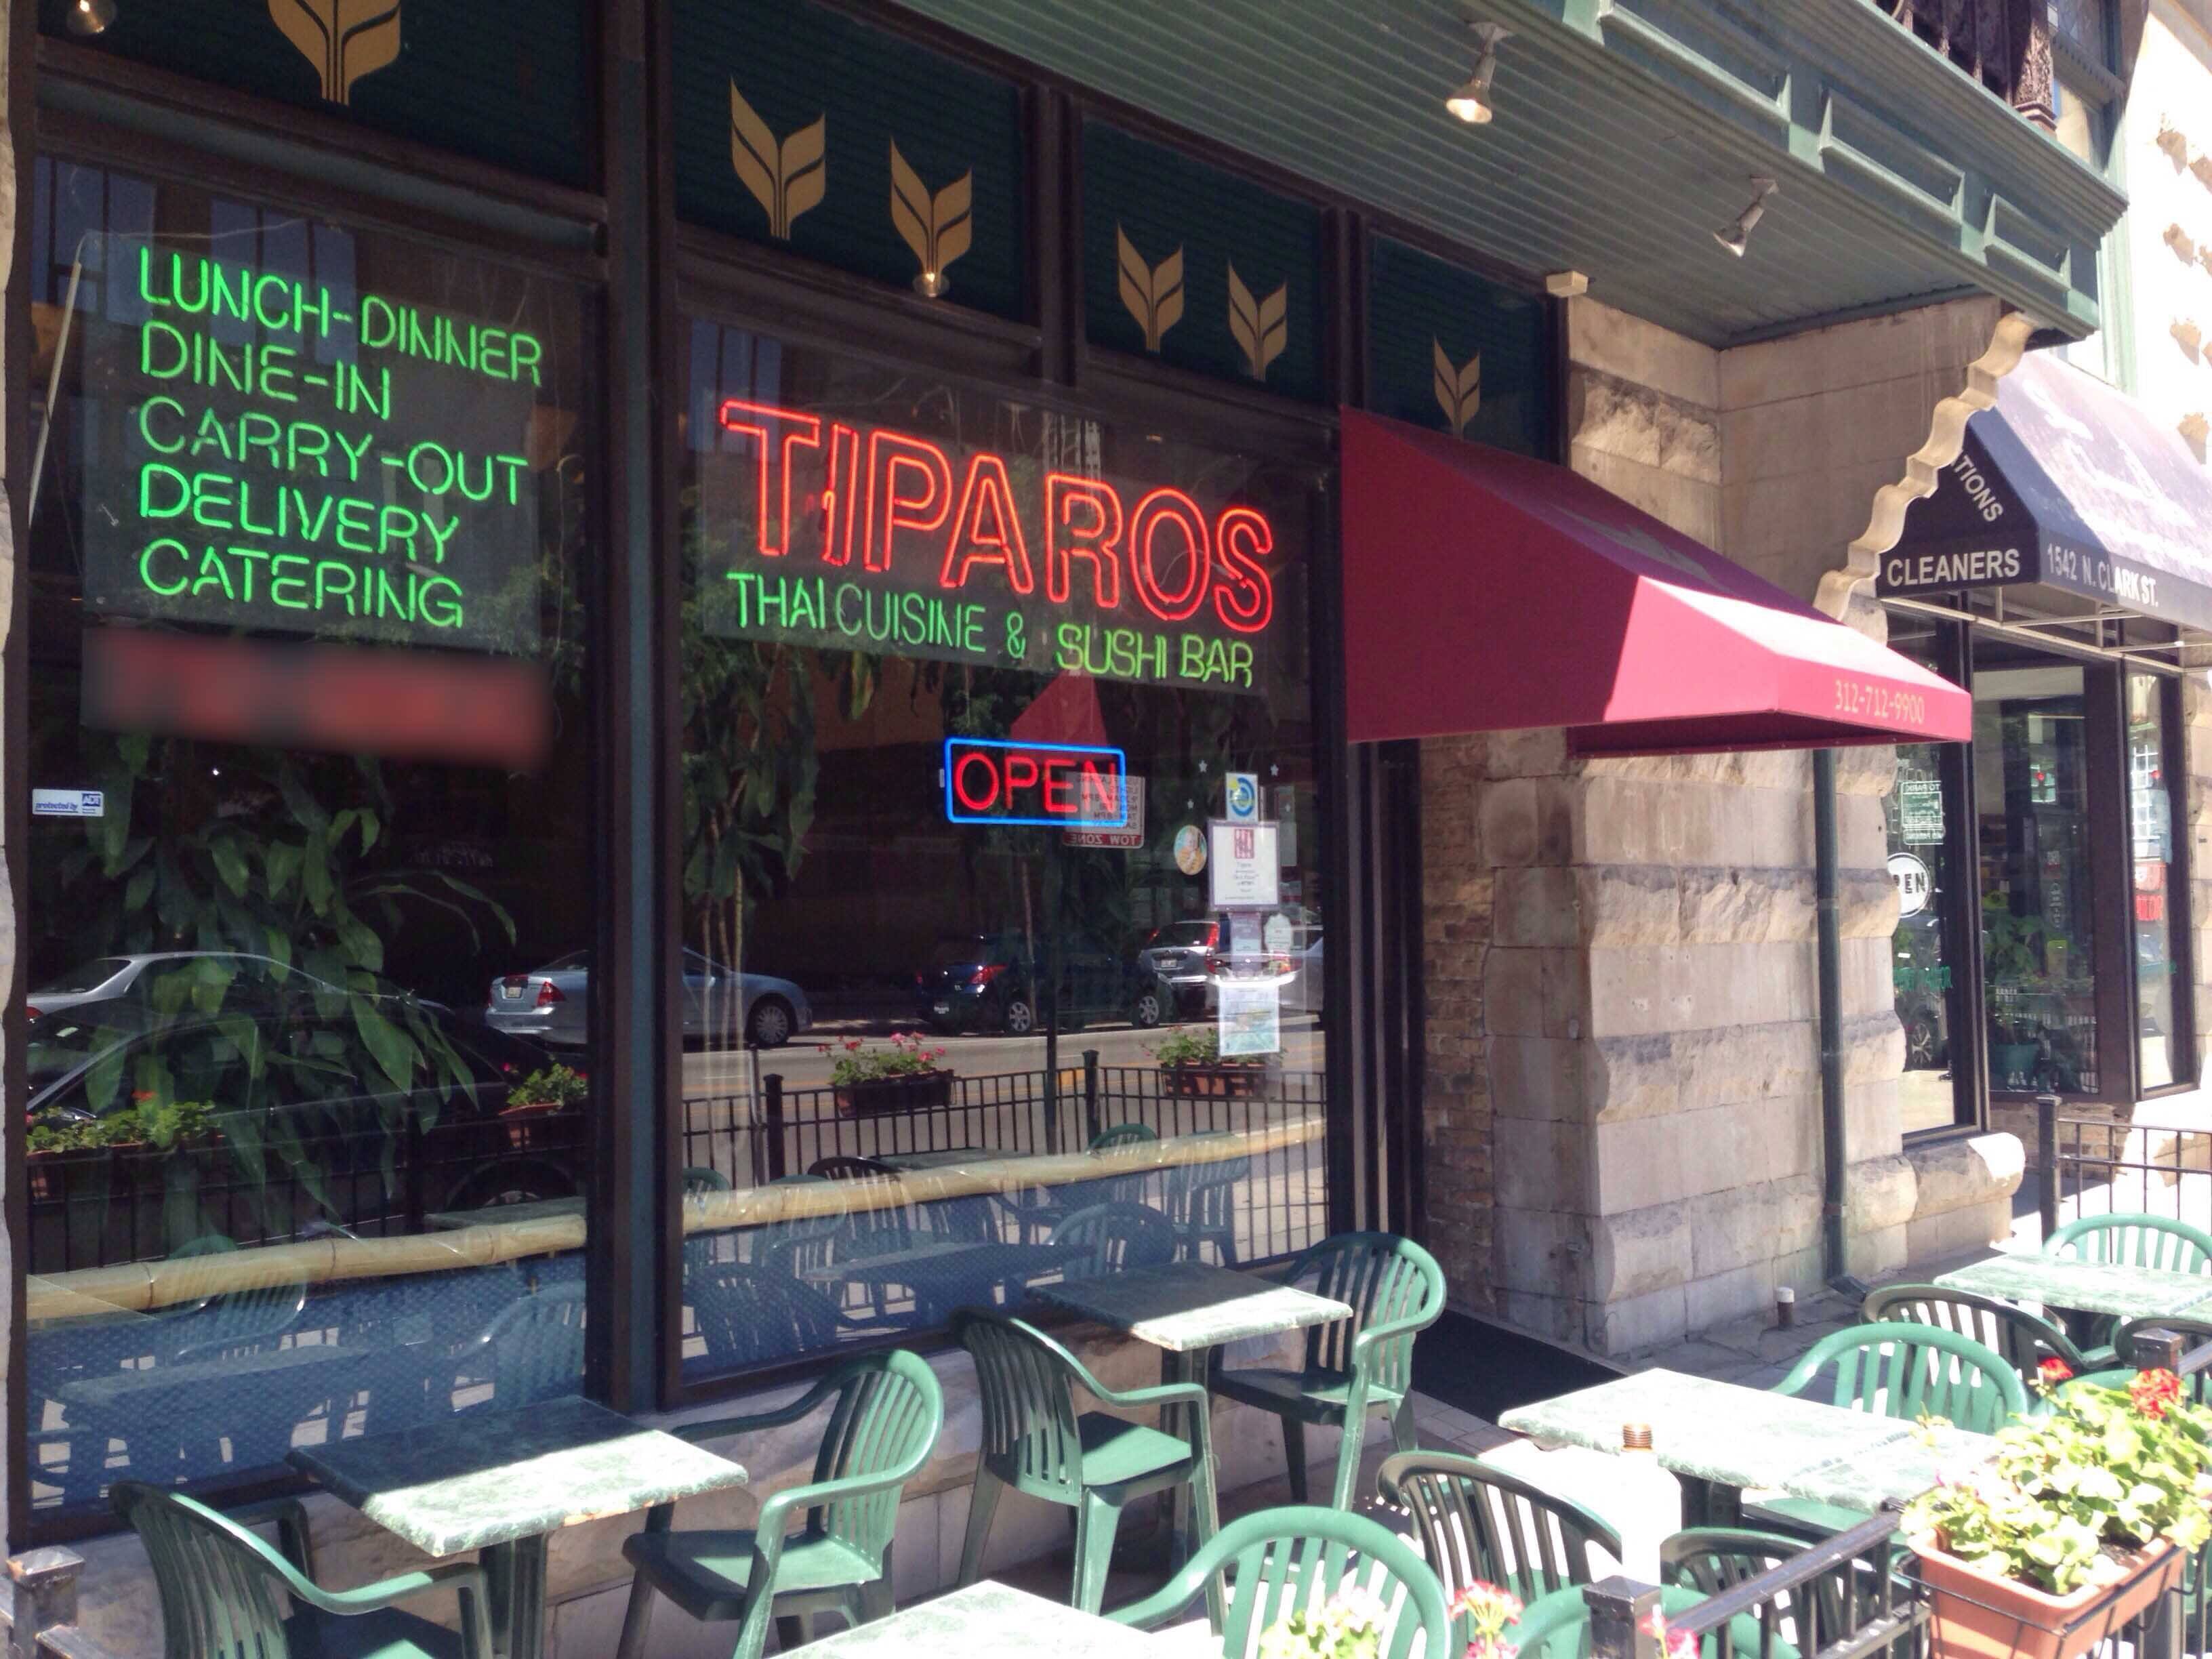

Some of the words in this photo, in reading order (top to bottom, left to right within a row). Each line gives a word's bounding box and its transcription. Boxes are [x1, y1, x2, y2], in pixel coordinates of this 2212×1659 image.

[140, 245, 544, 386] LUNCH-DINNER
[140, 320, 390, 420] DINE-IN
[140, 463, 459, 564] DELIVERY
[720, 400, 1274, 633] TIPAROS
[139, 538, 464, 628] CATERING
[1887, 548, 2021, 588] CLEANERS
[2047, 543, 2077, 581] 1542
[2083, 555, 2096, 588] N.
[2098, 560, 2141, 602] CLARK
[2141, 575, 2159, 608] ST.
[726, 572, 826, 629] THAI
[835, 583, 987, 654] CUISINE
[1006, 610, 1027, 659] &
[1055, 623, 1168, 680] SUSHI
[1180, 634, 1254, 690] BAR
[1834, 680, 1925, 726] 312-712-9900
[954, 752, 1118, 815] OPEN
